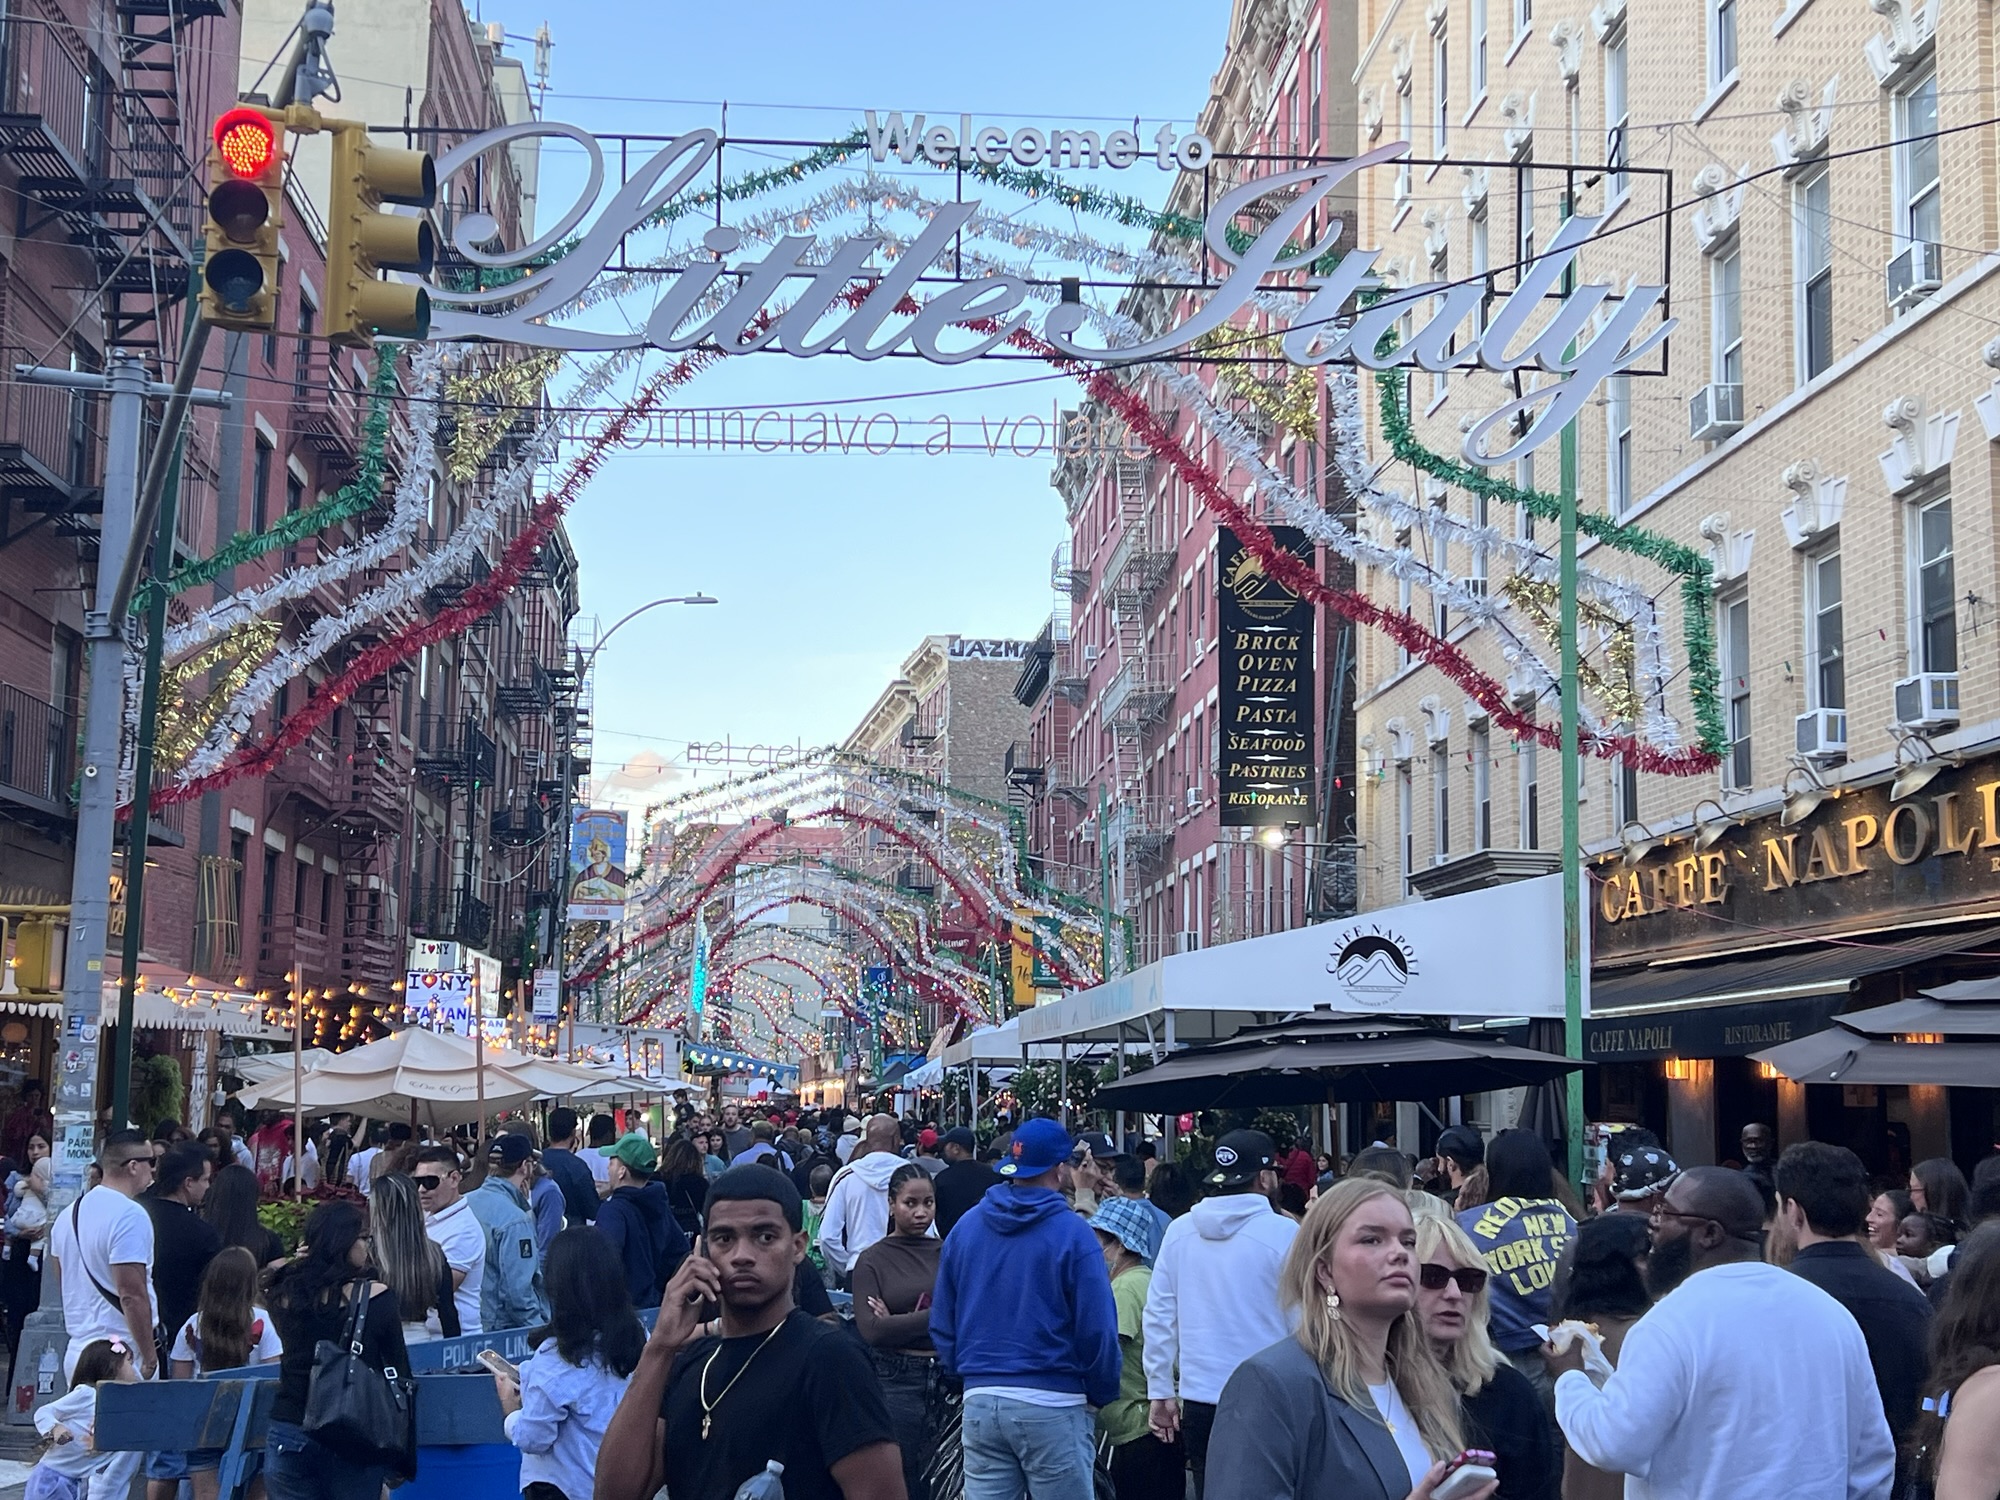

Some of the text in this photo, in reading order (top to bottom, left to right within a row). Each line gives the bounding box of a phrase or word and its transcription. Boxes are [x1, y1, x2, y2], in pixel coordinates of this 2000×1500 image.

[864, 109, 1212, 171] Welcome to
[427, 121, 1680, 467] Little Italy
[925, 413, 952, 456] a
[1222, 547, 1249, 588] CAFF
[1234, 632, 1299, 651] BRICK
[1238, 654, 1297, 672] OVEN
[1236, 675, 1297, 693] PIZZA
[1236, 705, 1297, 724] PASTA
[687, 733, 730, 765] nel
[747, 736, 825, 770] cielo
[1228, 736, 1306, 752] SEAFOOD
[1229, 763, 1307, 779] PASTRIES
[1228, 792, 1308, 806] RISTORANTE
[1600, 781, 2000, 923] CAFFE NAPOLI
[436, 943, 449, 955] NY
[1325, 923, 1419, 976] CAFFE NAPOLI
[439, 974, 470, 991] NY
[1590, 1026, 1673, 1053] CAFFE NAPOLI
[1724, 1022, 1791, 1046] RISTORANTE
[1522, 1213, 1567, 1237] NEW
[1483, 1237, 1549, 1275] YORK
